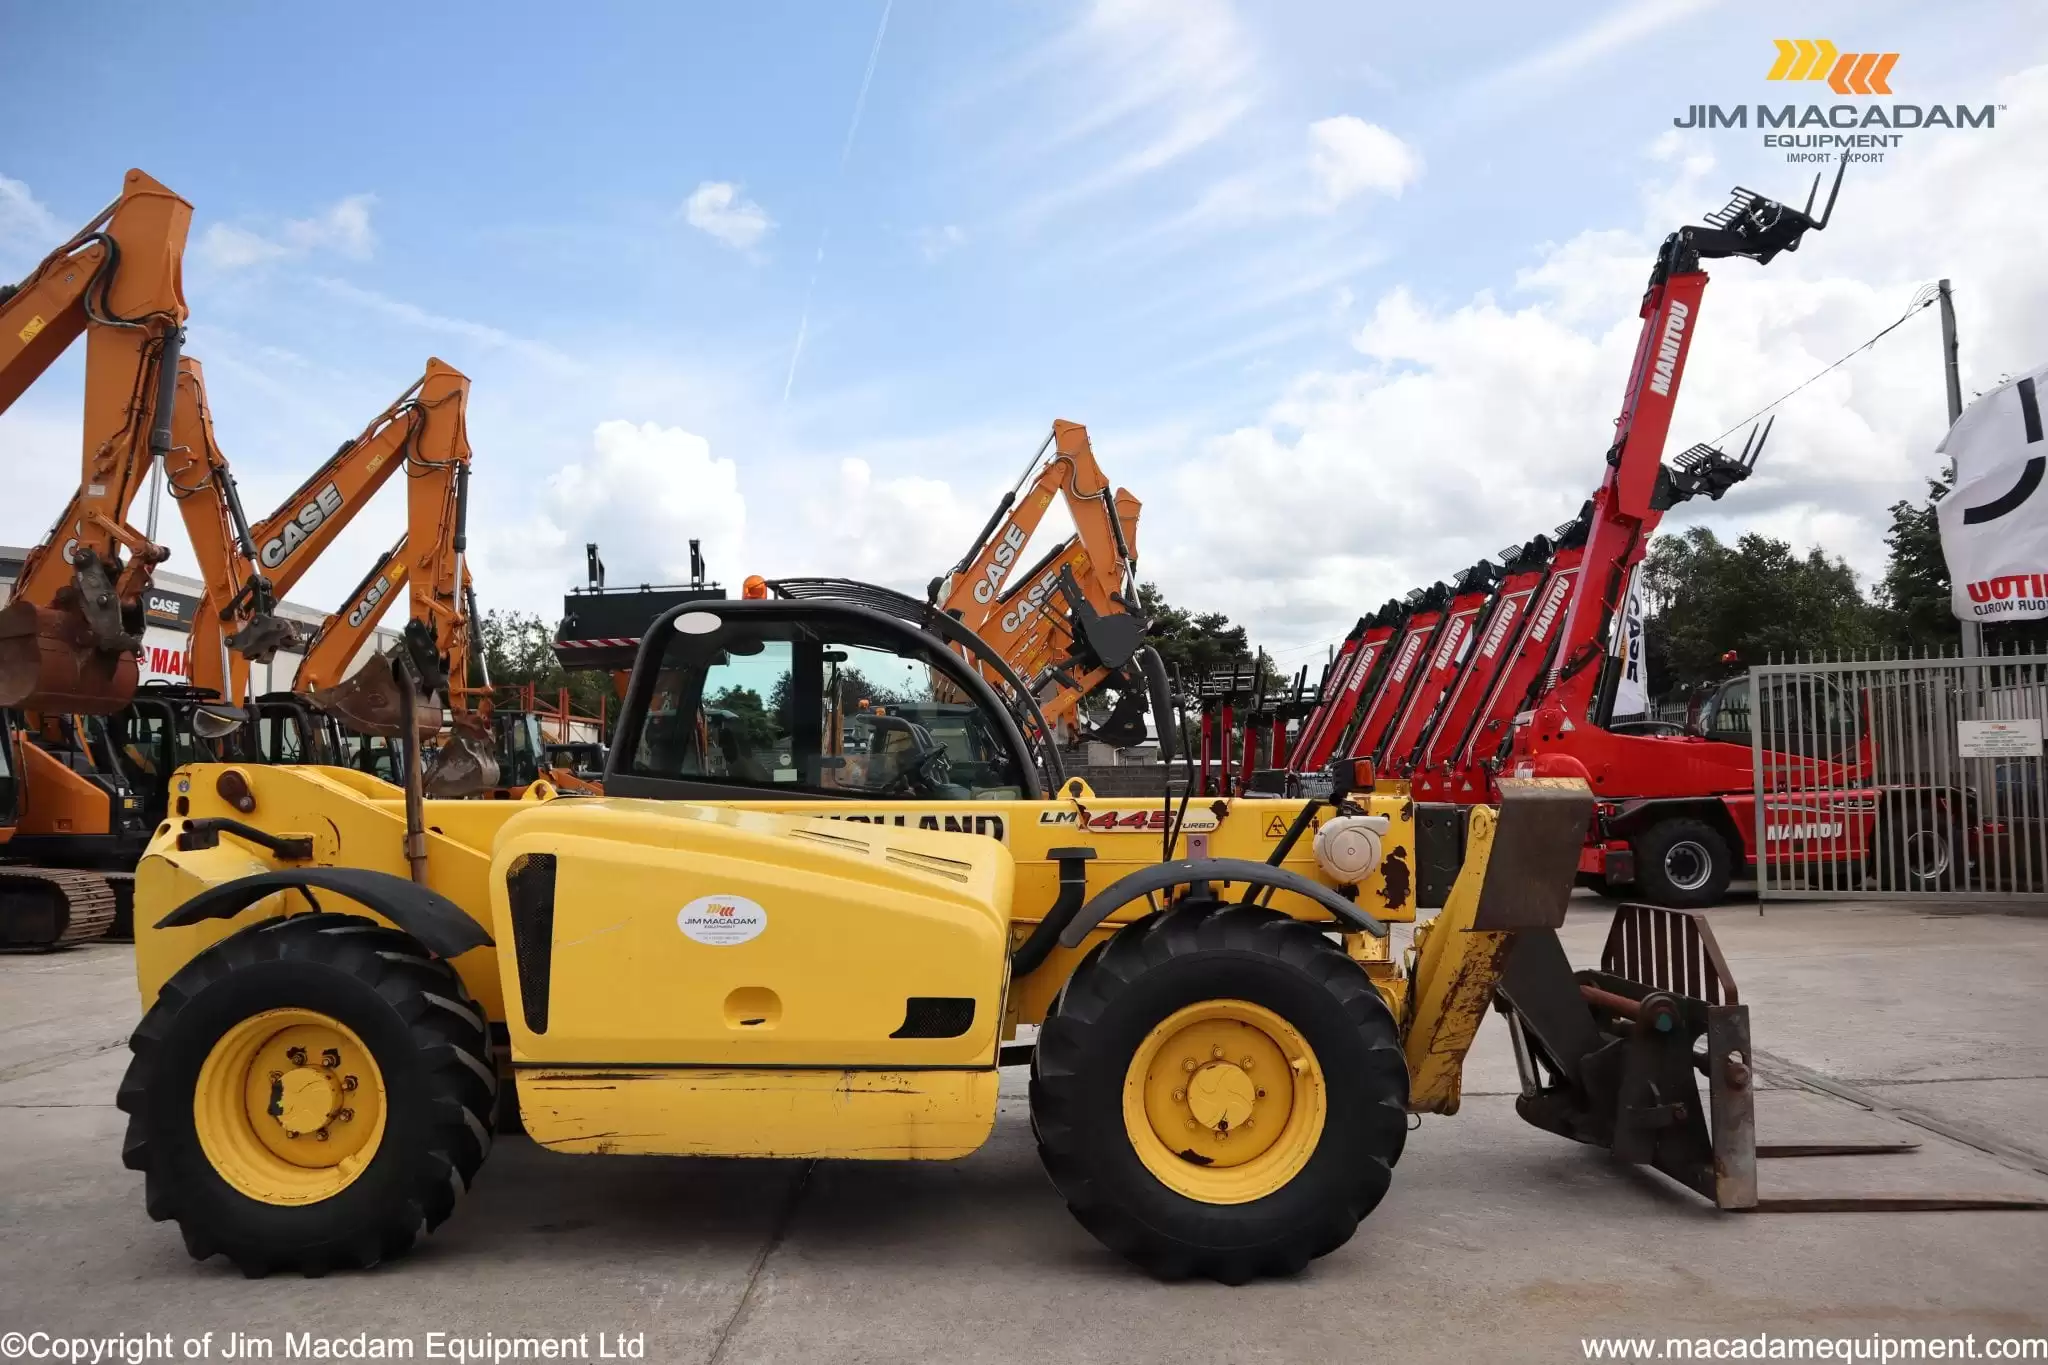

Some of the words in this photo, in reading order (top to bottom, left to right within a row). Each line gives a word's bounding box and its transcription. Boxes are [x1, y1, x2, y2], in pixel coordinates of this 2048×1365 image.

[1649, 299, 1689, 397] MANITOU
[260, 480, 344, 569] CASE
[973, 523, 1027, 604] CASE
[149, 596, 181, 615] CASE
[348, 575, 391, 628] CASE
[1001, 570, 1059, 633] CASE
[1482, 600, 1518, 659] MANITOU
[1531, 576, 1570, 643] MANITOU
[1349, 647, 1375, 692] MANITOU
[1393, 635, 1422, 684] MANITOU
[1435, 618, 1466, 671] MANITOU
[1180, 821, 1216, 829] URBO
